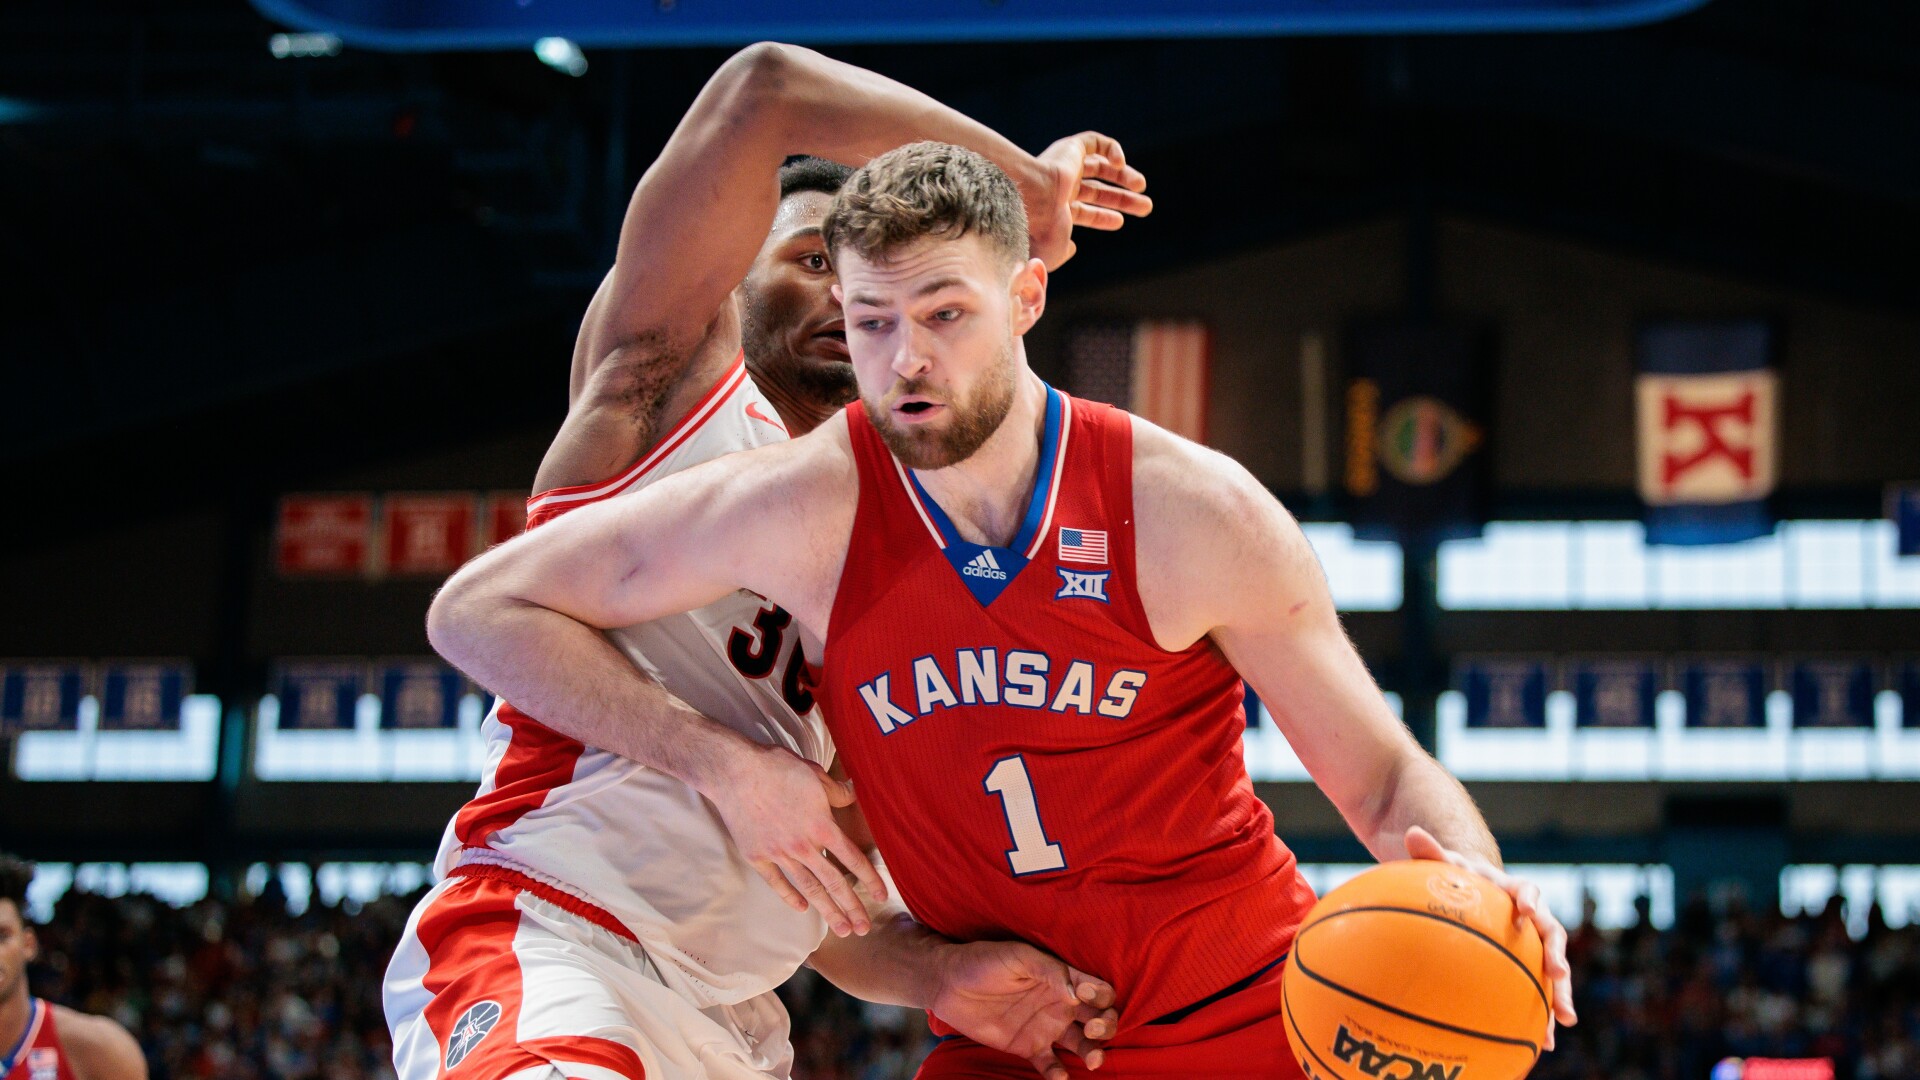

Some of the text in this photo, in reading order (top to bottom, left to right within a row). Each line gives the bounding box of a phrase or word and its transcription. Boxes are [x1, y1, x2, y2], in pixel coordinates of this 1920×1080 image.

[1663, 388, 1754, 488] K
[962, 565, 1007, 580] adidas
[1056, 568, 1110, 602] XII
[857, 647, 1147, 736] KANSAS
[982, 753, 1068, 878] 1
